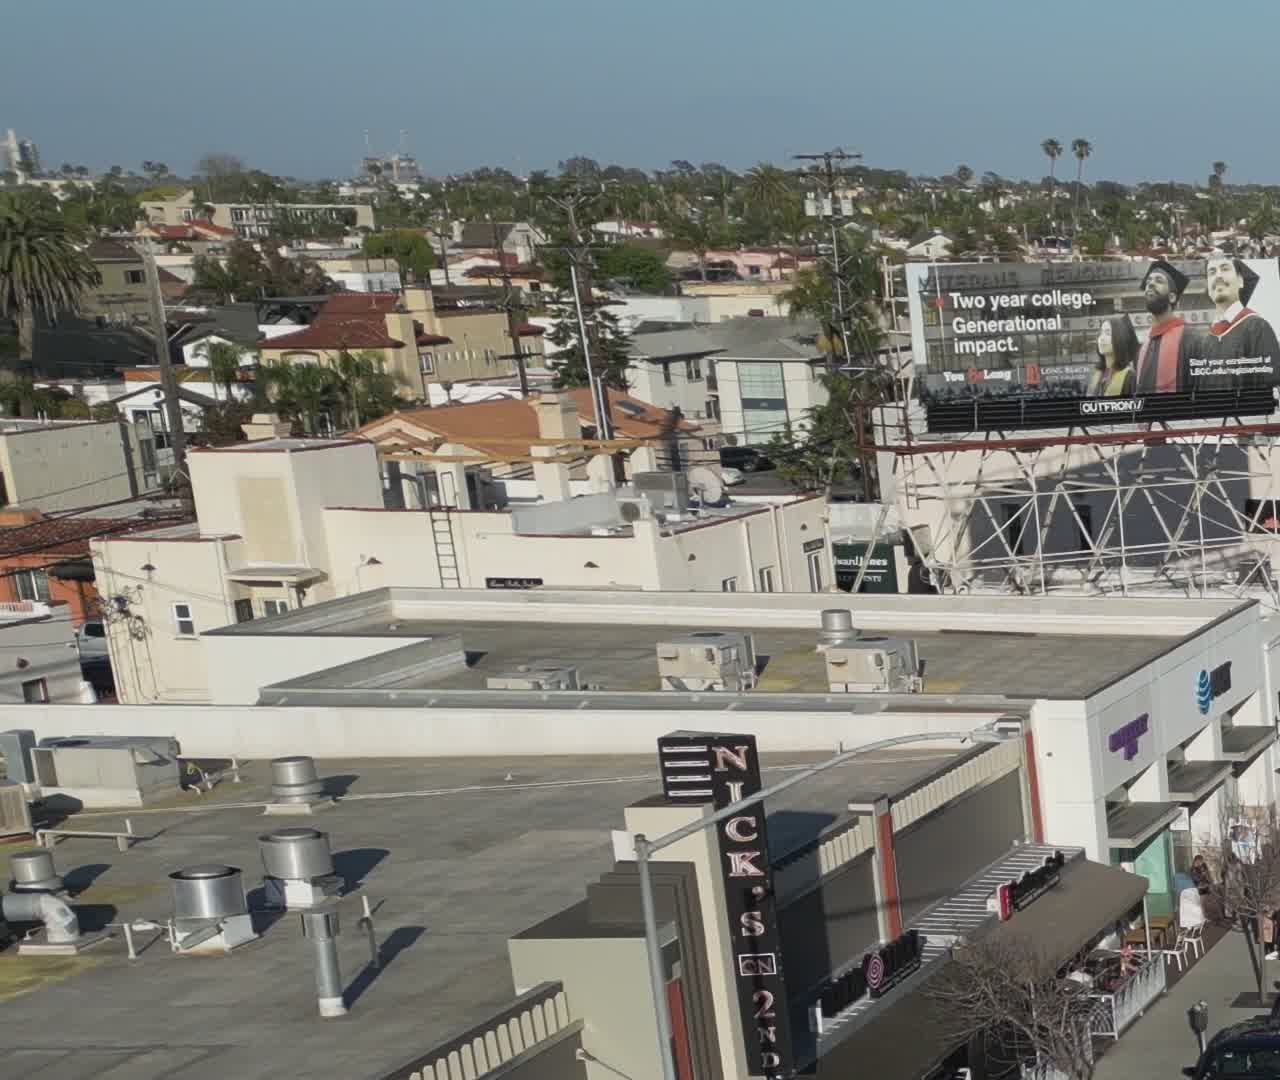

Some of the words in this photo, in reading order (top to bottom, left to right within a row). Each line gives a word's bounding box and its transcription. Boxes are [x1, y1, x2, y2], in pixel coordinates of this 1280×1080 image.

[949, 291, 986, 309] Two
[990, 293, 1030, 312] year
[1031, 290, 1097, 310] college.
[952, 314, 1062, 334] Generational
[954, 336, 1019, 357] impact.
